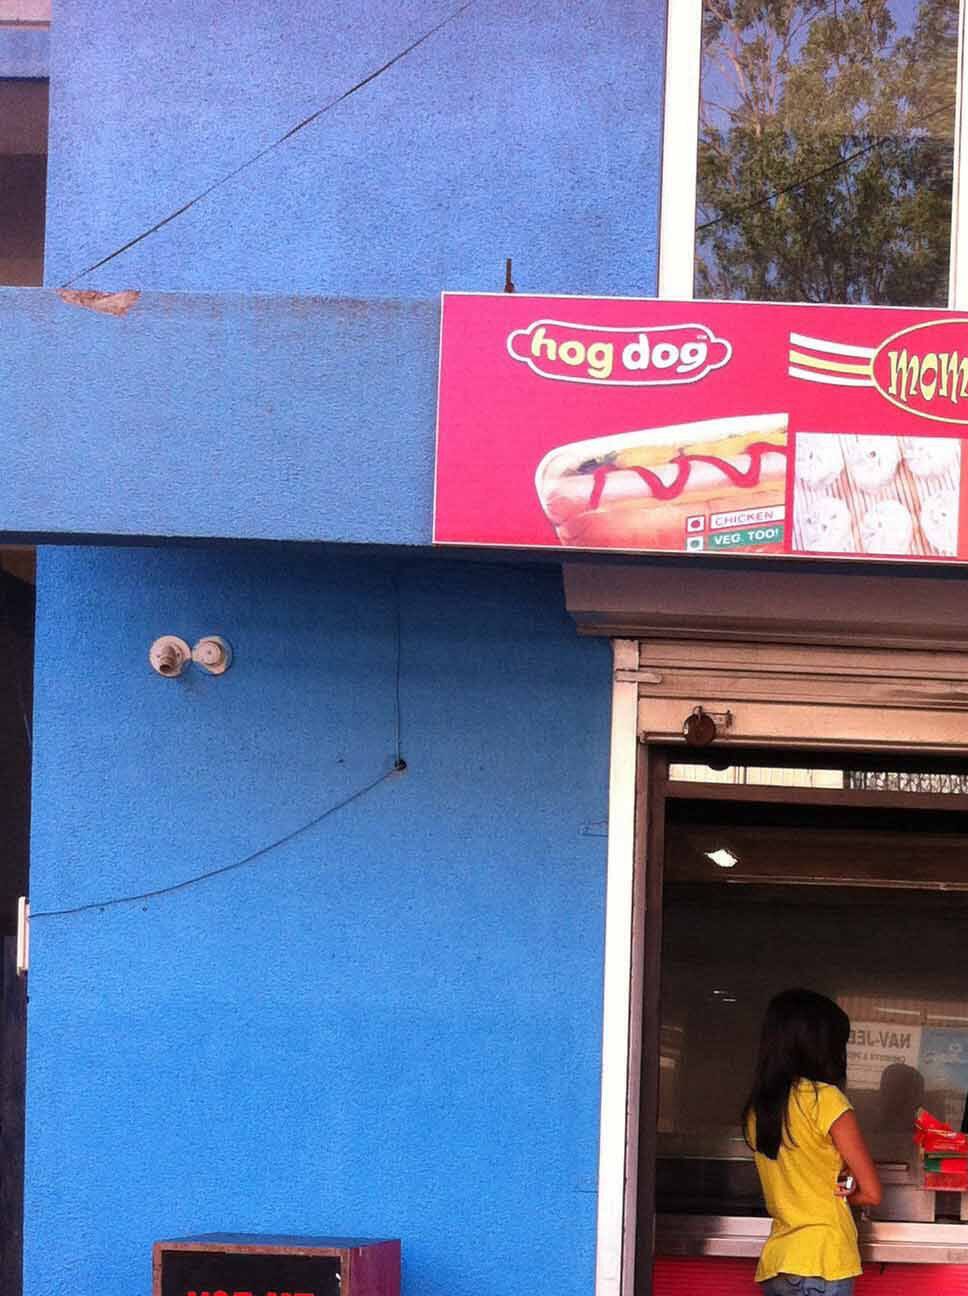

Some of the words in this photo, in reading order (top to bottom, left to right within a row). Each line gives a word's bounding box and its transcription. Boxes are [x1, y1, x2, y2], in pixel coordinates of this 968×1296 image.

[531, 328, 613, 378] hog
[622, 334, 708, 373] dog
[715, 511, 774, 526] CHICKEN
[714, 532, 741, 545] VEG
[748, 528, 780, 541] TOO!
